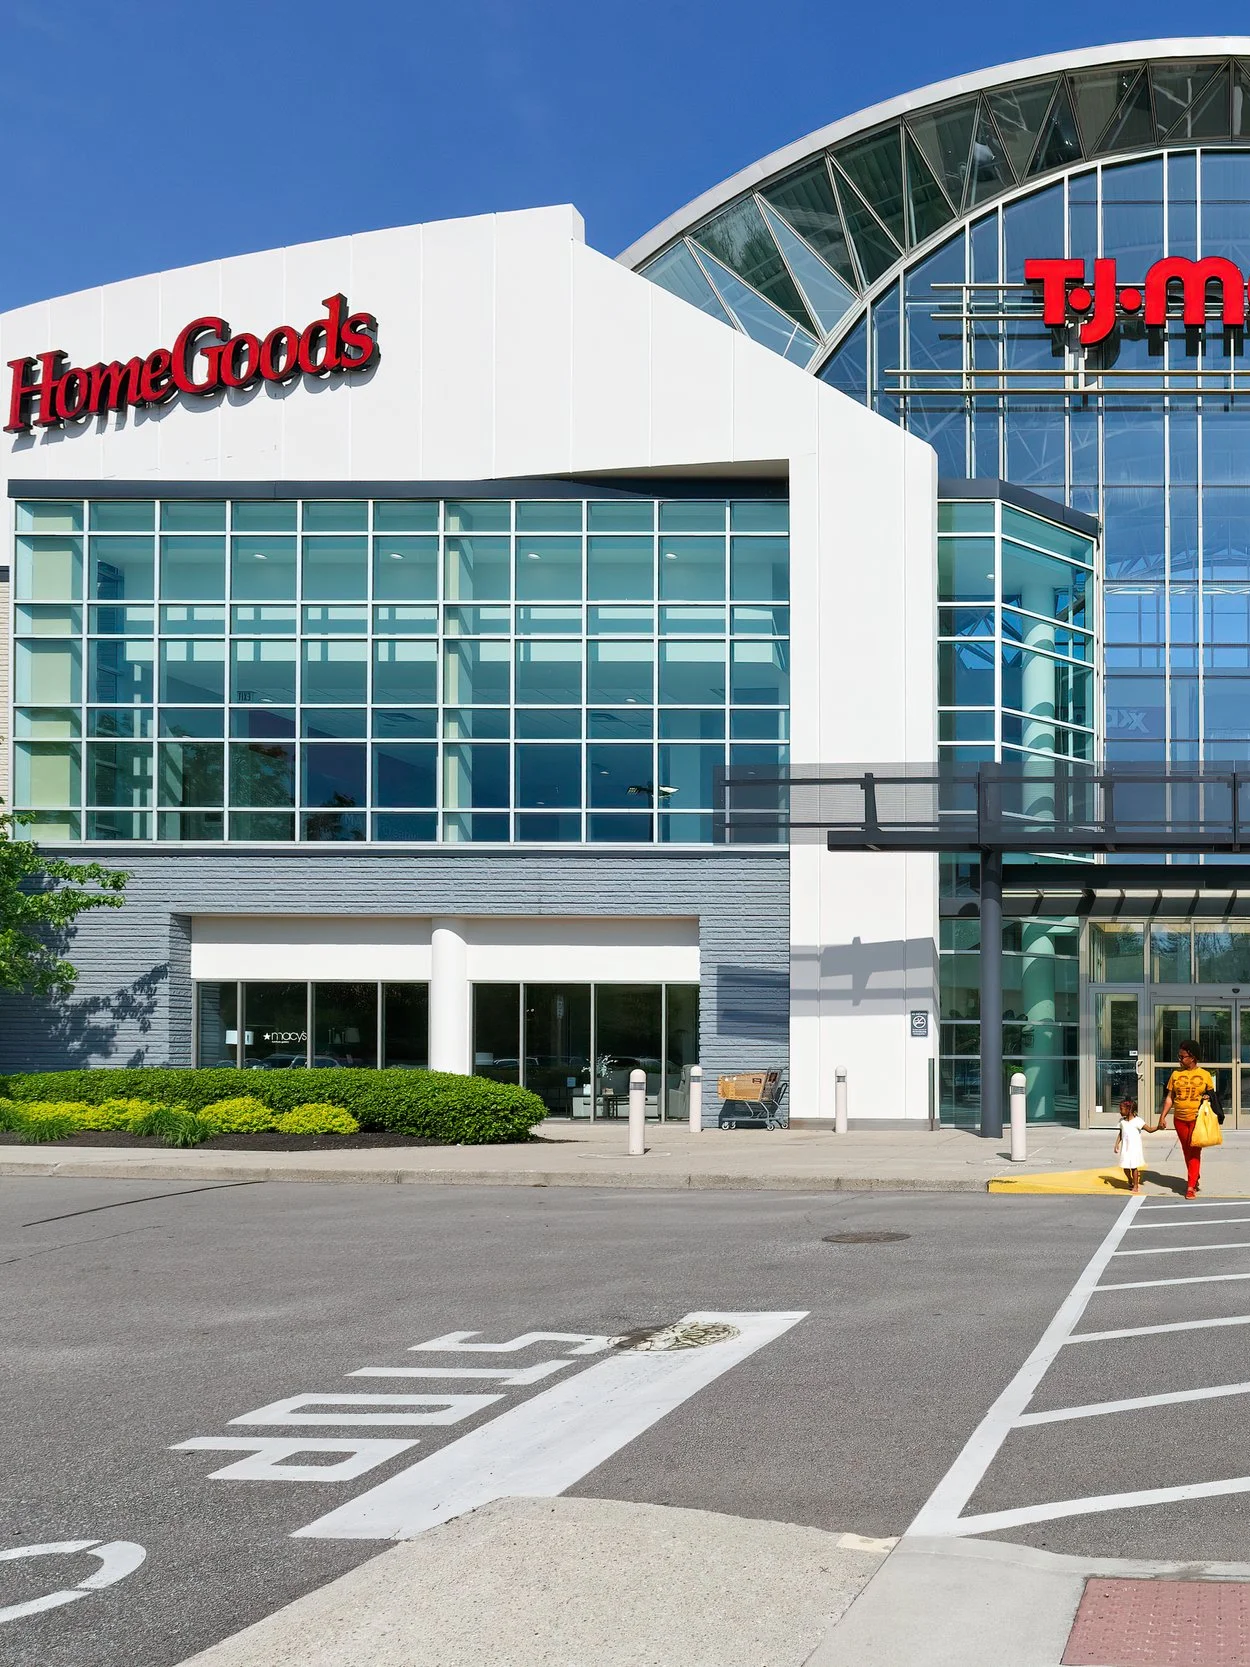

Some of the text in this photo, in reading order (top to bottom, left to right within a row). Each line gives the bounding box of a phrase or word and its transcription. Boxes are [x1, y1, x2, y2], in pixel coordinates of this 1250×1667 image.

[3, 292, 381, 434] HomeGoods
[271, 1031, 307, 1043] macy's
[166, 1331, 618, 1482] STOP
